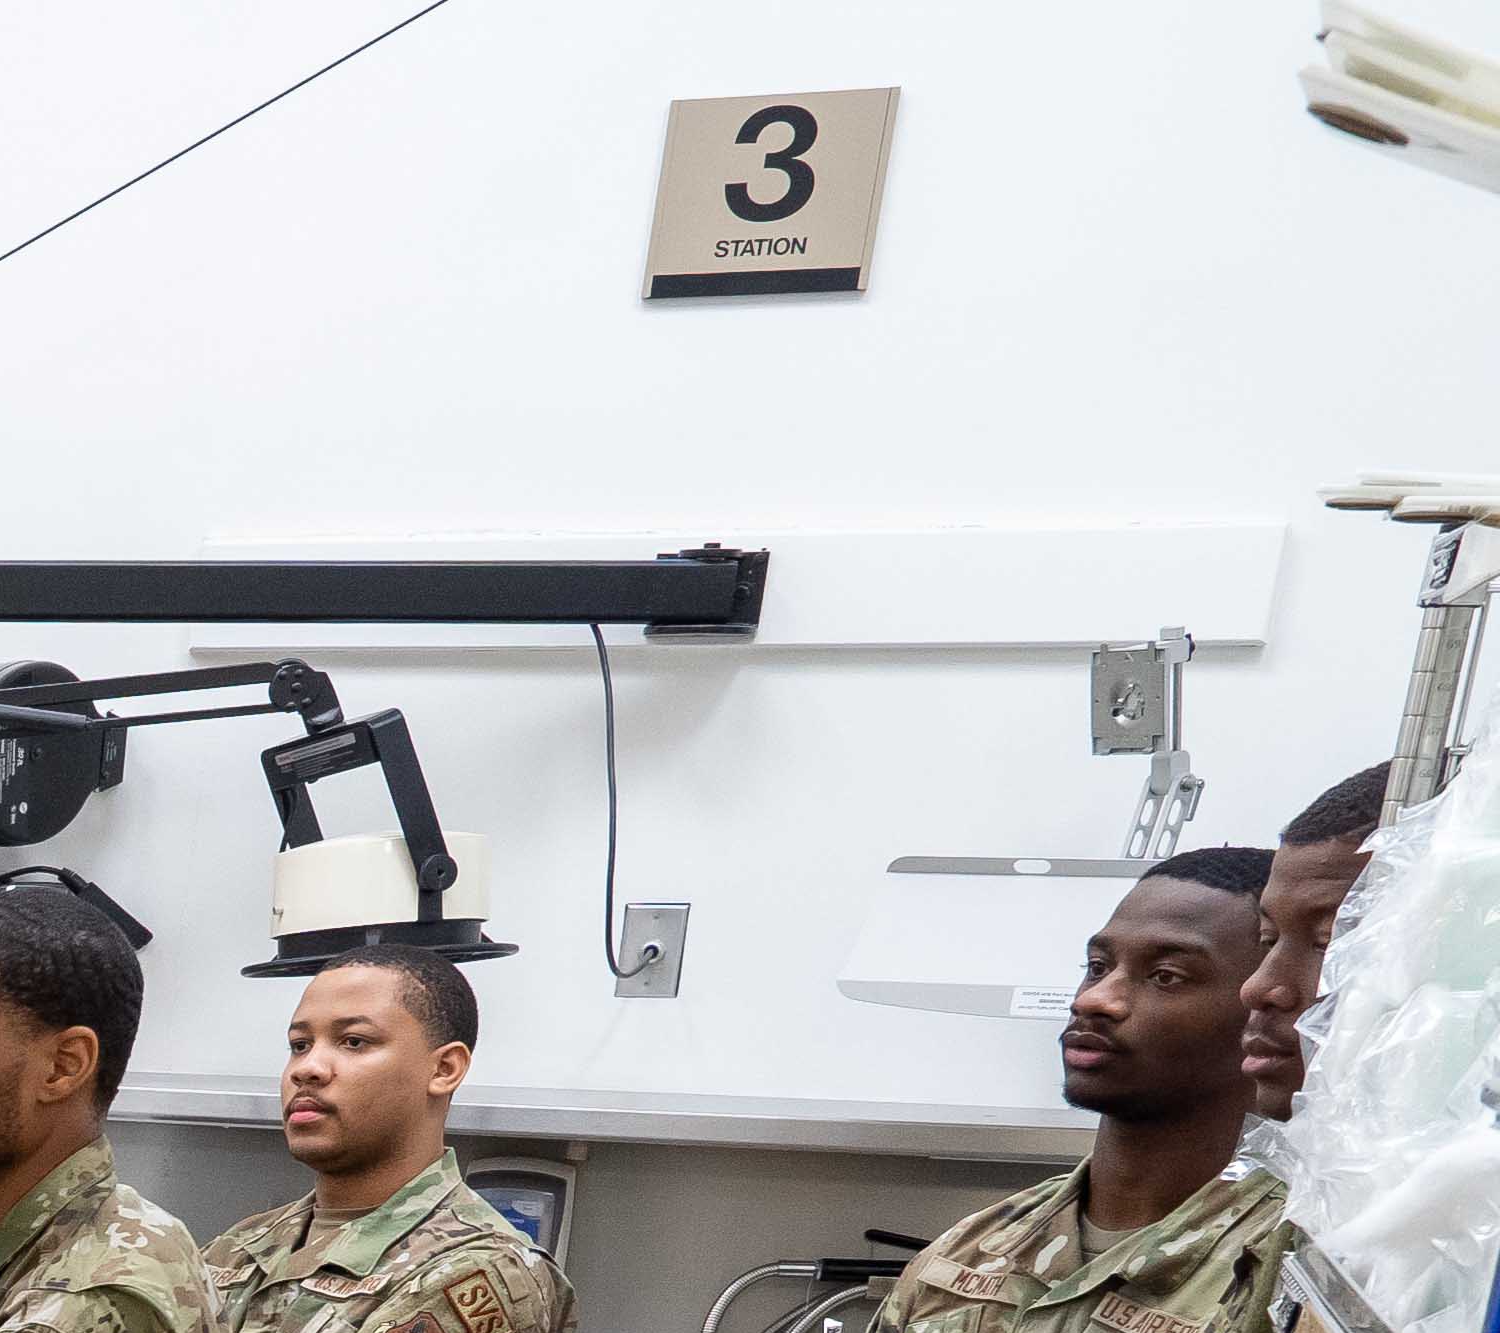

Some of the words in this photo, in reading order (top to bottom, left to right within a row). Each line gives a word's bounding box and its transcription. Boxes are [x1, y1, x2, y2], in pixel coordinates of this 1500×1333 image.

[724, 104, 819, 223] 3
[713, 236, 808, 260] STATION
[950, 1269, 1006, 1296] MCMATH
[1101, 1294, 1134, 1328] U.S.
